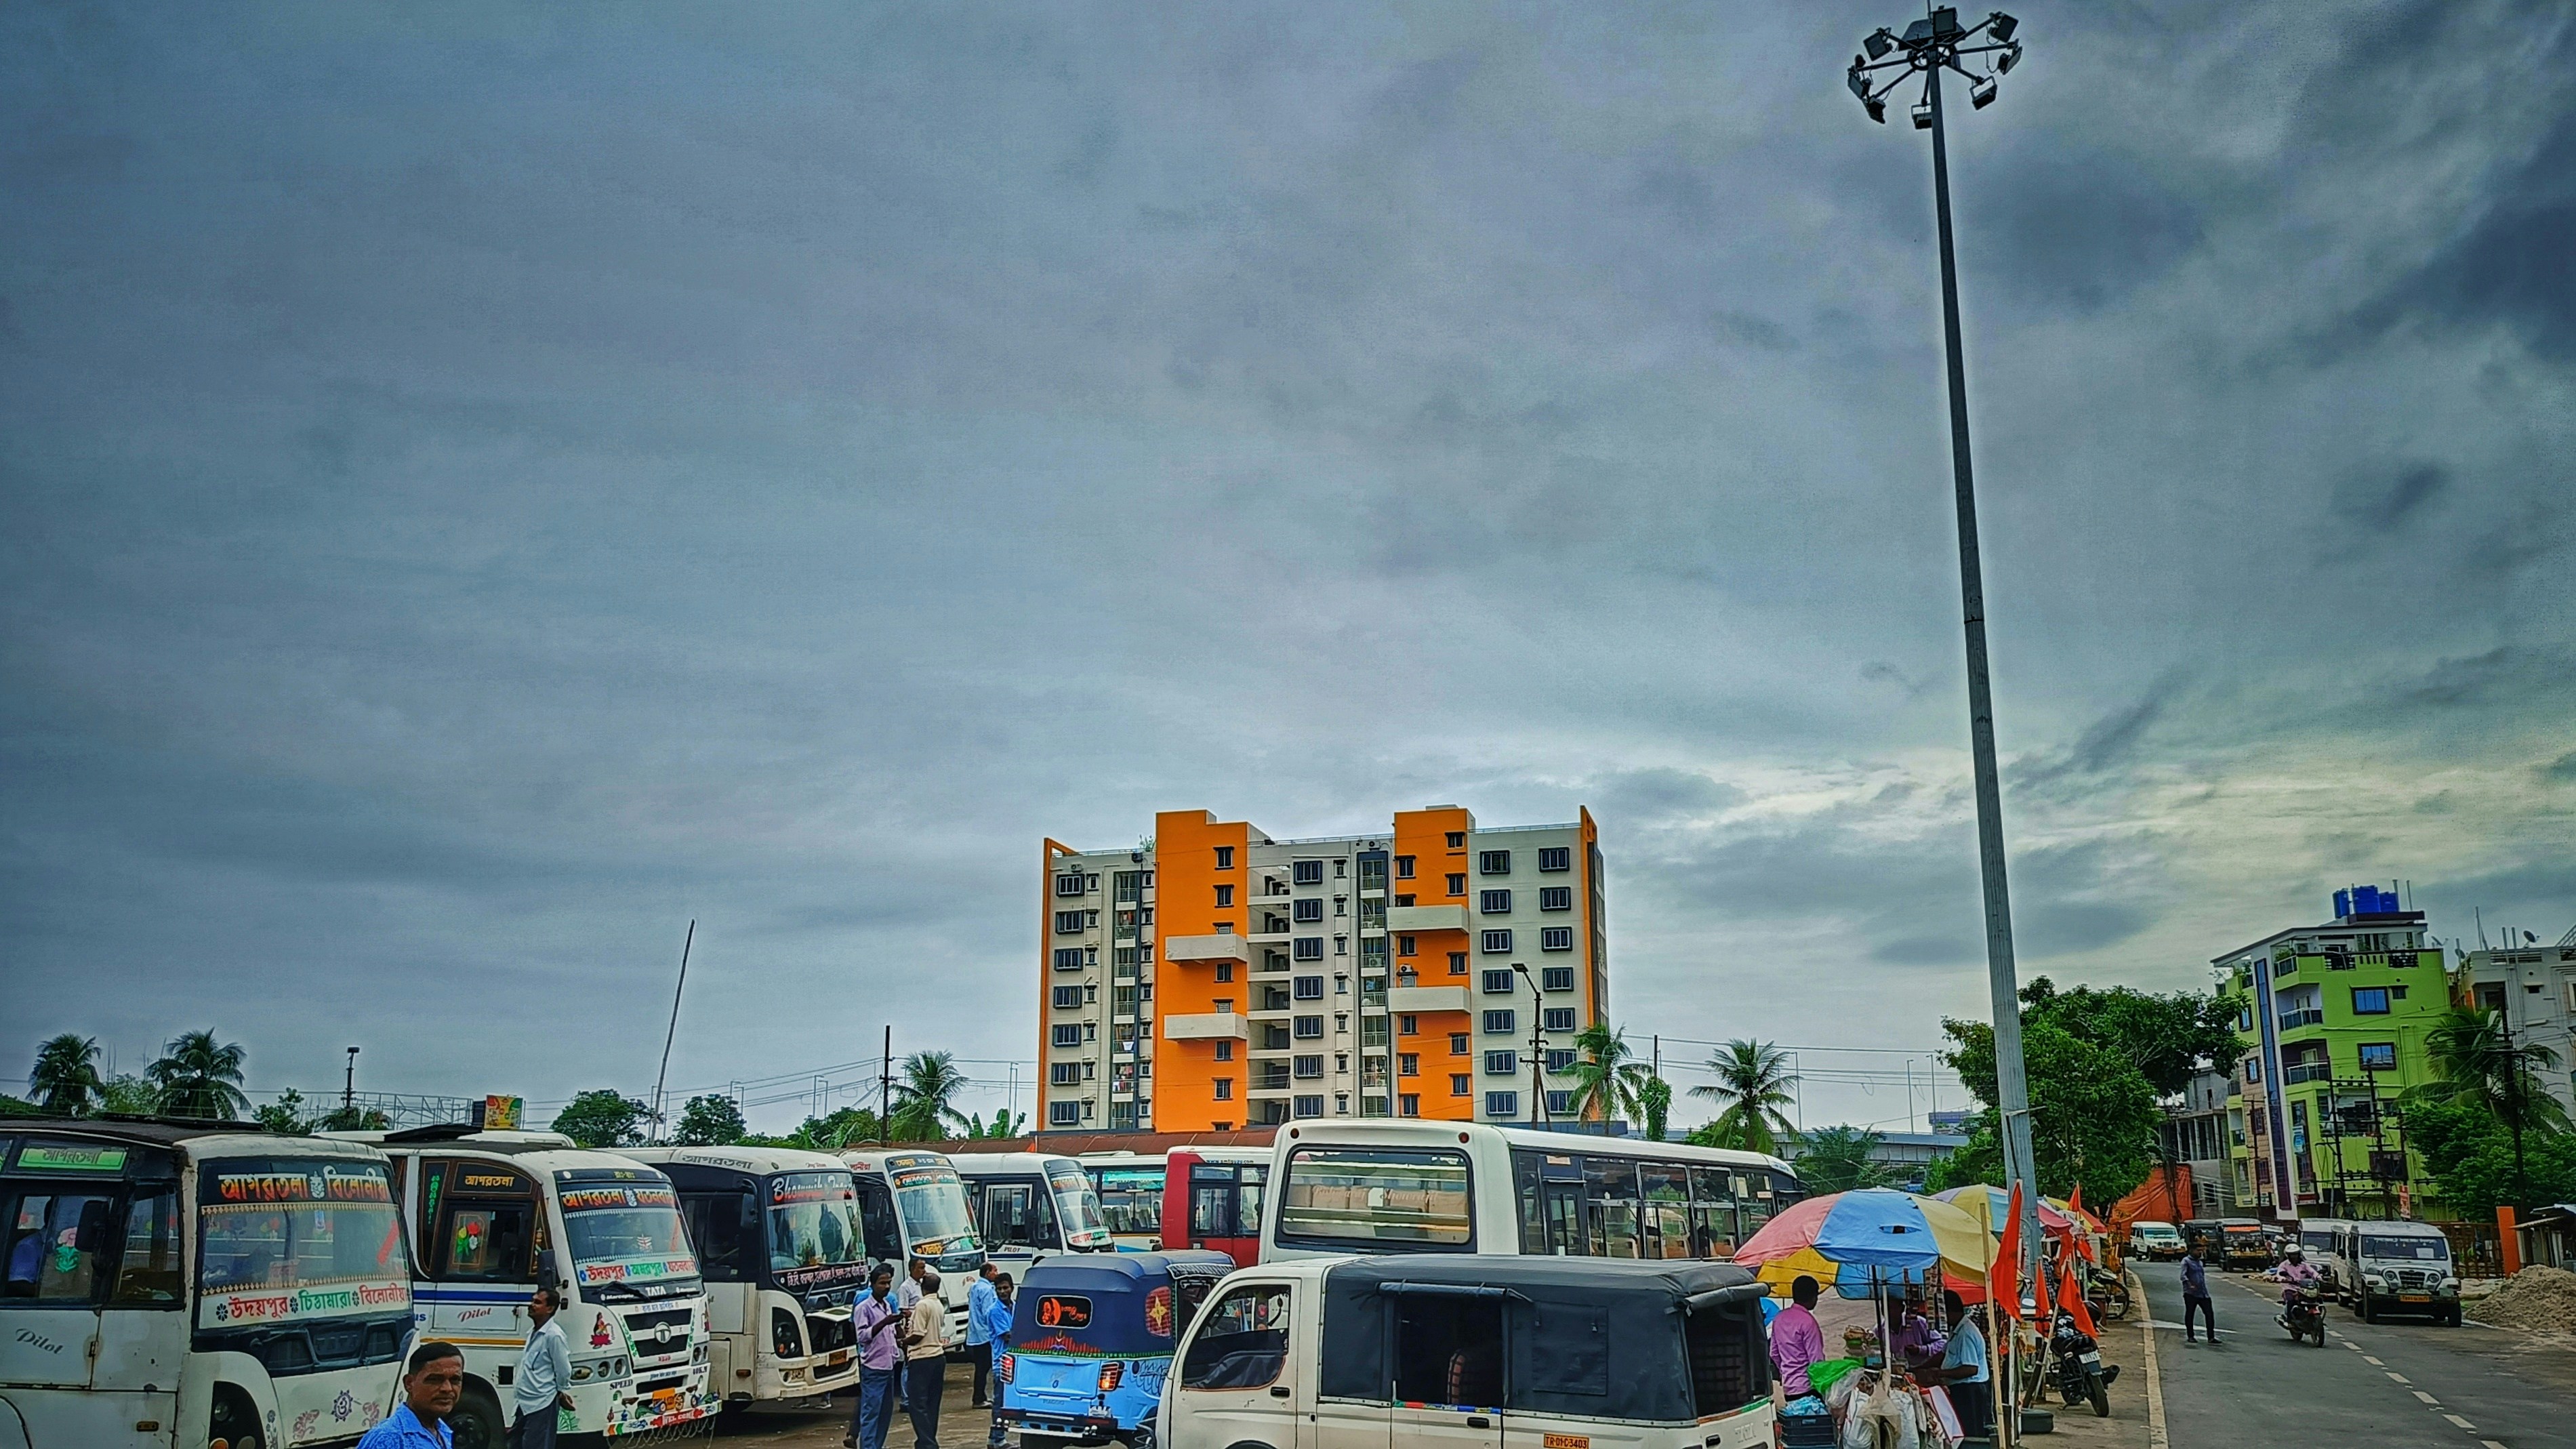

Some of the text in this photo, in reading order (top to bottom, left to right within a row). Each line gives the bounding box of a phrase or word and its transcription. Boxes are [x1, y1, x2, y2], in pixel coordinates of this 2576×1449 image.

[43, 1147, 102, 1164] আগরতলা
[682, 1155, 753, 1169] আগরতলা
[218, 1165, 388, 1201] আগরতলা বিলোনীয়া
[465, 1175, 514, 1187] আগরতলা
[560, 1189, 626, 1207] আগরতলা
[586, 1265, 626, 1281] উদয়পুর
[631, 1263, 663, 1278] অমরপুর
[645, 1286, 666, 1296] TATA
[228, 1296, 288, 1319] উদয়পুর
[457, 1307, 491, 1322] Pilot
[16, 1328, 63, 1354] Pilot
[610, 1379, 633, 1389] SPEED
